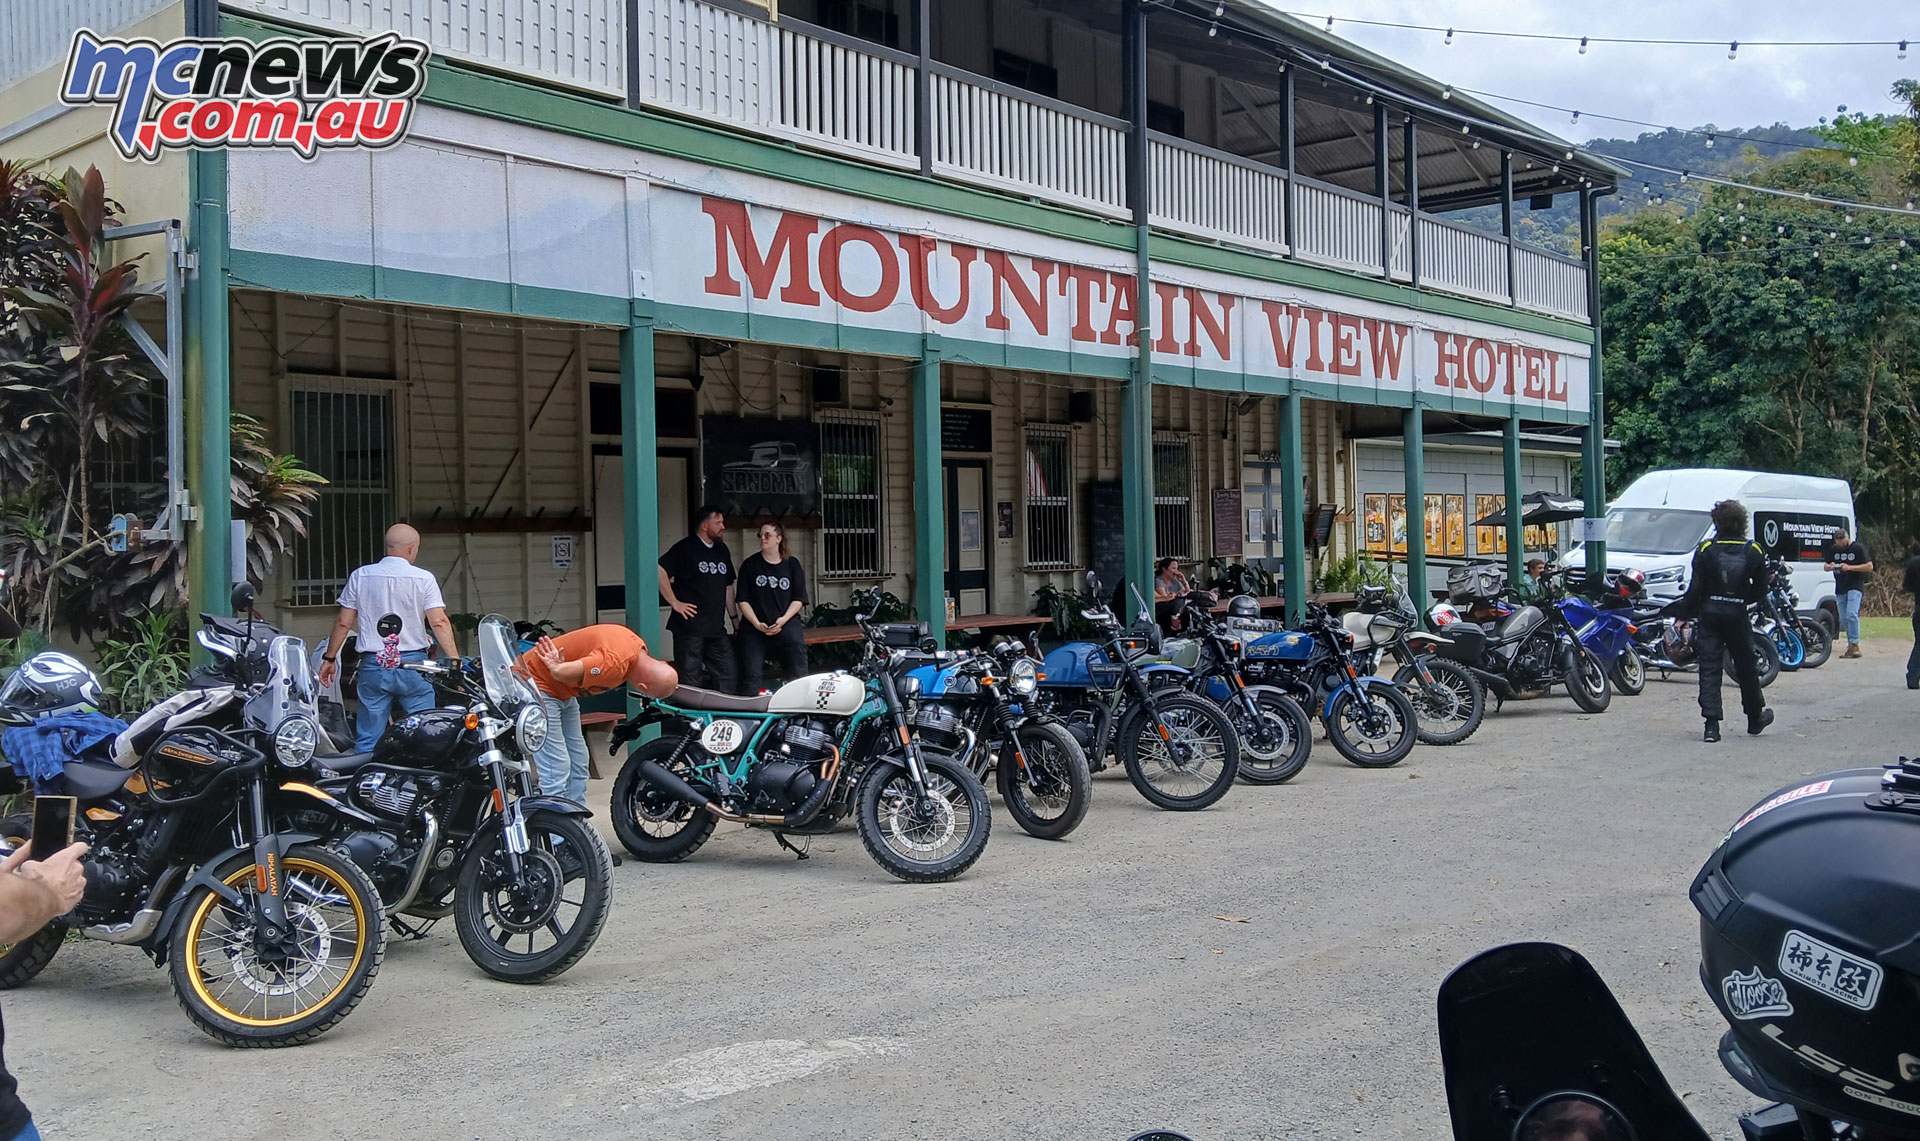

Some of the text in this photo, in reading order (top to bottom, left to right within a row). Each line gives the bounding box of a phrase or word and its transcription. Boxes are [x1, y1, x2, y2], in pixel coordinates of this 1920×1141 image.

[702, 196, 1569, 402] MOUNTAIN VIEW HOTEL
[55, 678, 78, 692] HJC
[710, 726, 733, 742] 249
[267, 852, 279, 897] HIMALAYAN
[1789, 967, 1859, 1003] KAKIMOTO RACING
[1760, 1023, 1896, 1094] LS2
[1844, 1086, 1884, 1104] DON'T
